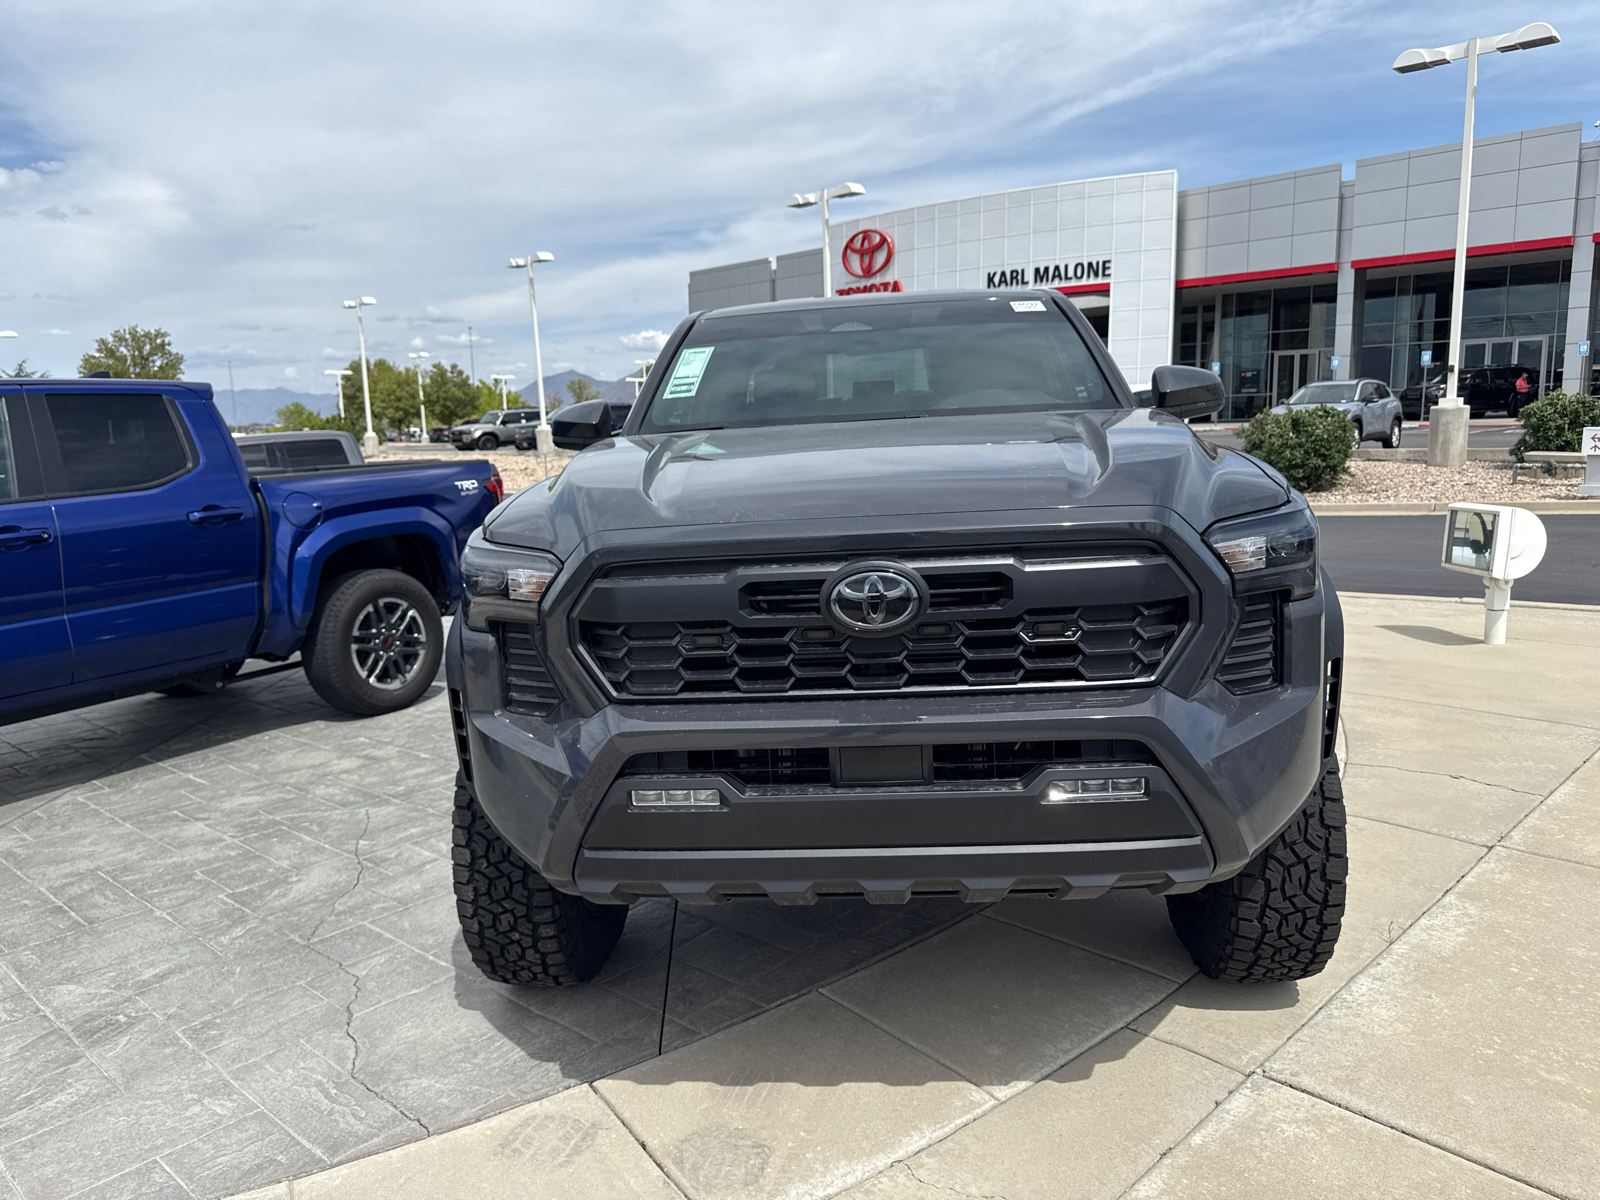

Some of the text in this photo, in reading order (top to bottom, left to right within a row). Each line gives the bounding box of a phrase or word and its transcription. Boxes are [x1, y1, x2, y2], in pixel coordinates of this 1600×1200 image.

[986, 259, 1112, 289] KARL MALONE
[454, 479, 478, 490] TRD
